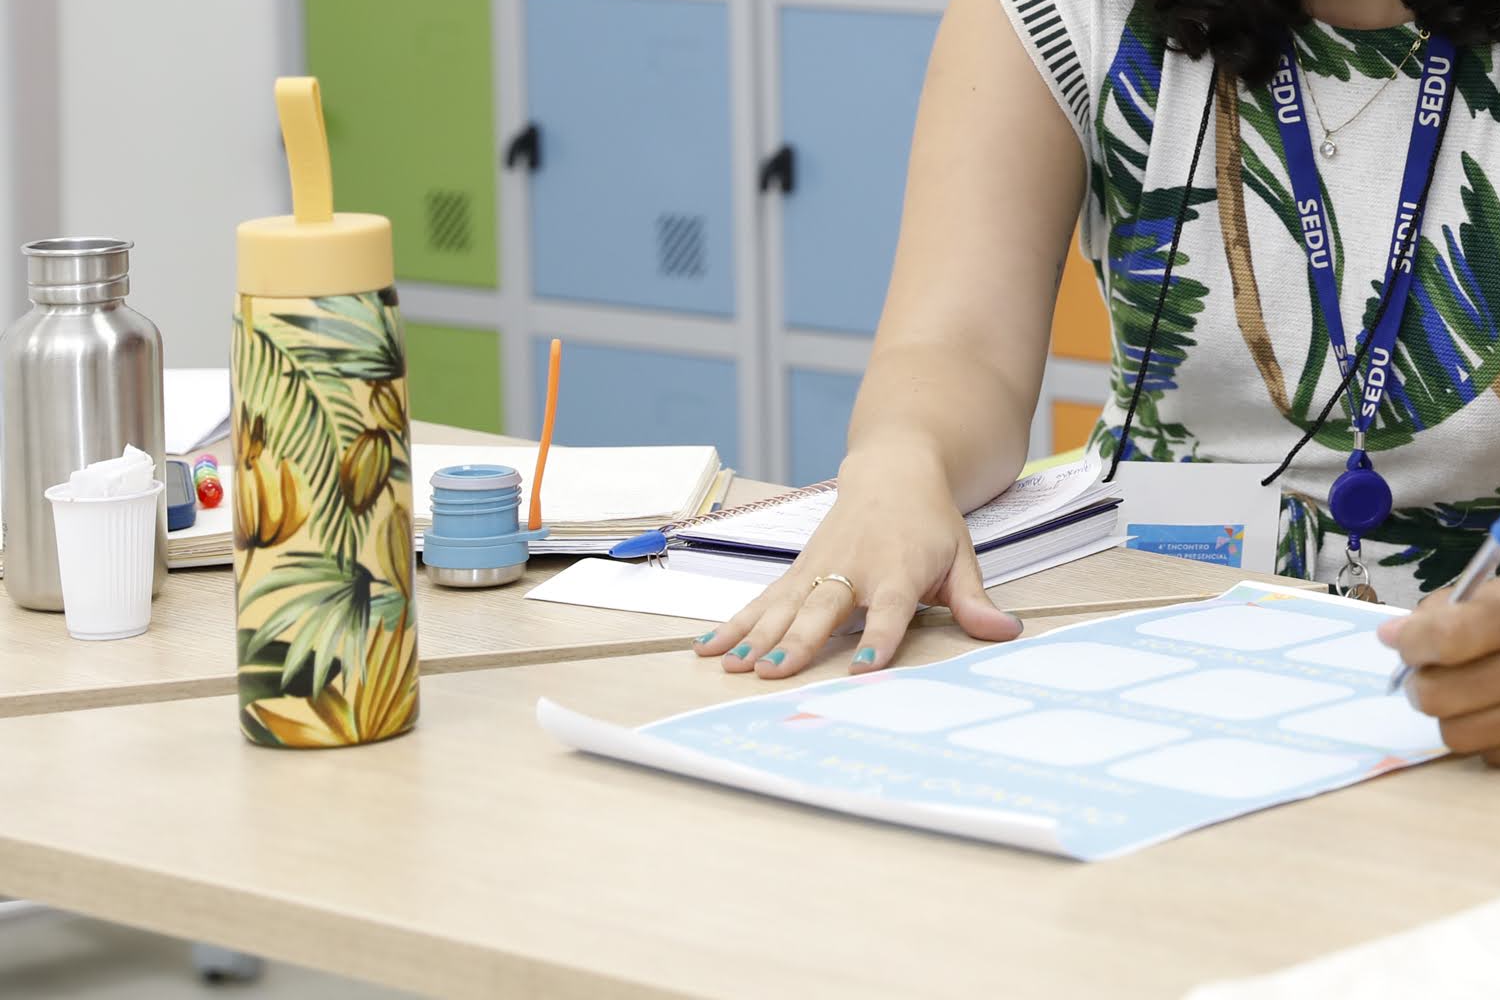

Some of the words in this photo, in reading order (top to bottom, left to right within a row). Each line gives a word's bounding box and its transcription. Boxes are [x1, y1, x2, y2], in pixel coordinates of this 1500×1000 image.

[1418, 55, 1451, 127] SEDU
[1297, 198, 1329, 269] SEDU
[1361, 347, 1390, 418] SEDU
[1167, 543, 1210, 551] ENCONTRO
